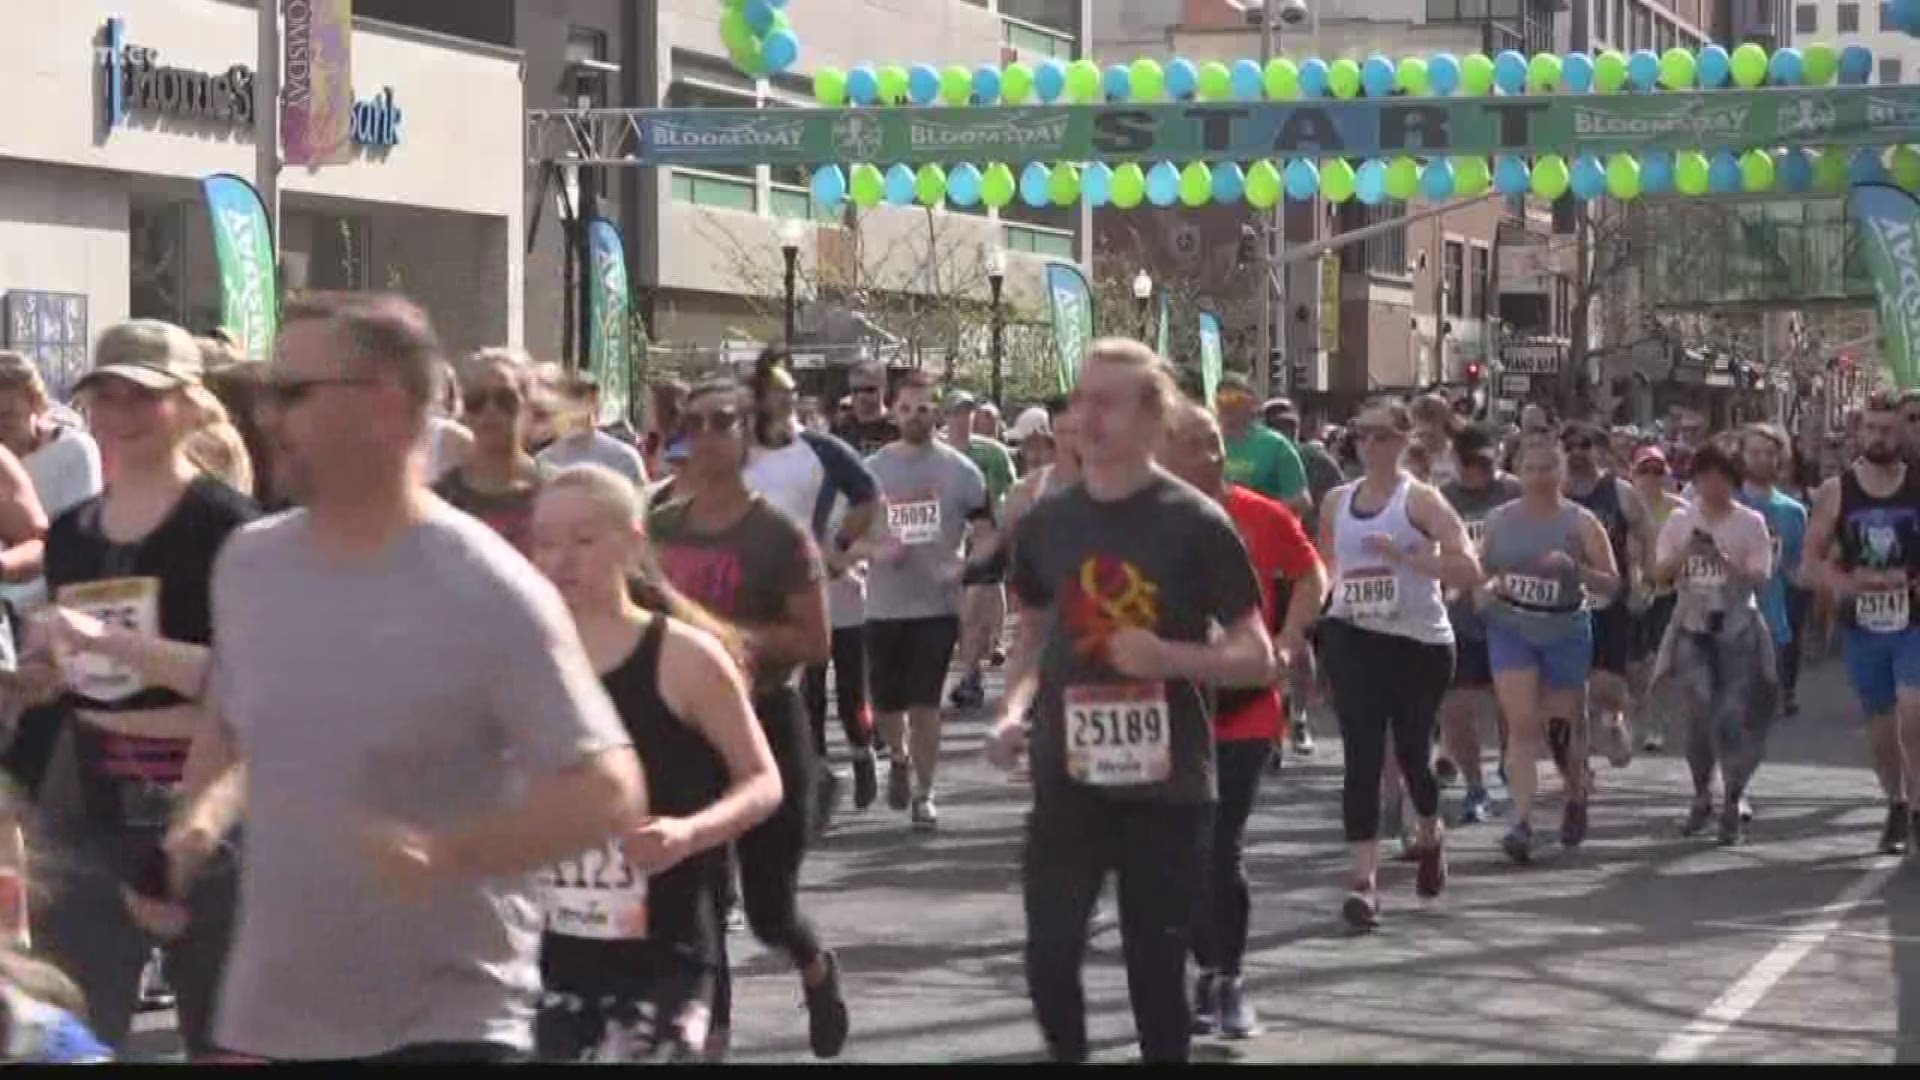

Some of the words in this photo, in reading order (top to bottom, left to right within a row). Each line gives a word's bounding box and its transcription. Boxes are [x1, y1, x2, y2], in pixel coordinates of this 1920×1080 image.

[652, 121, 805, 147] BLOOMSDAY
[910, 115, 1069, 145] BLOOMSDAY
[1091, 102, 1549, 153] START
[1074, 706, 1161, 747] 25189
